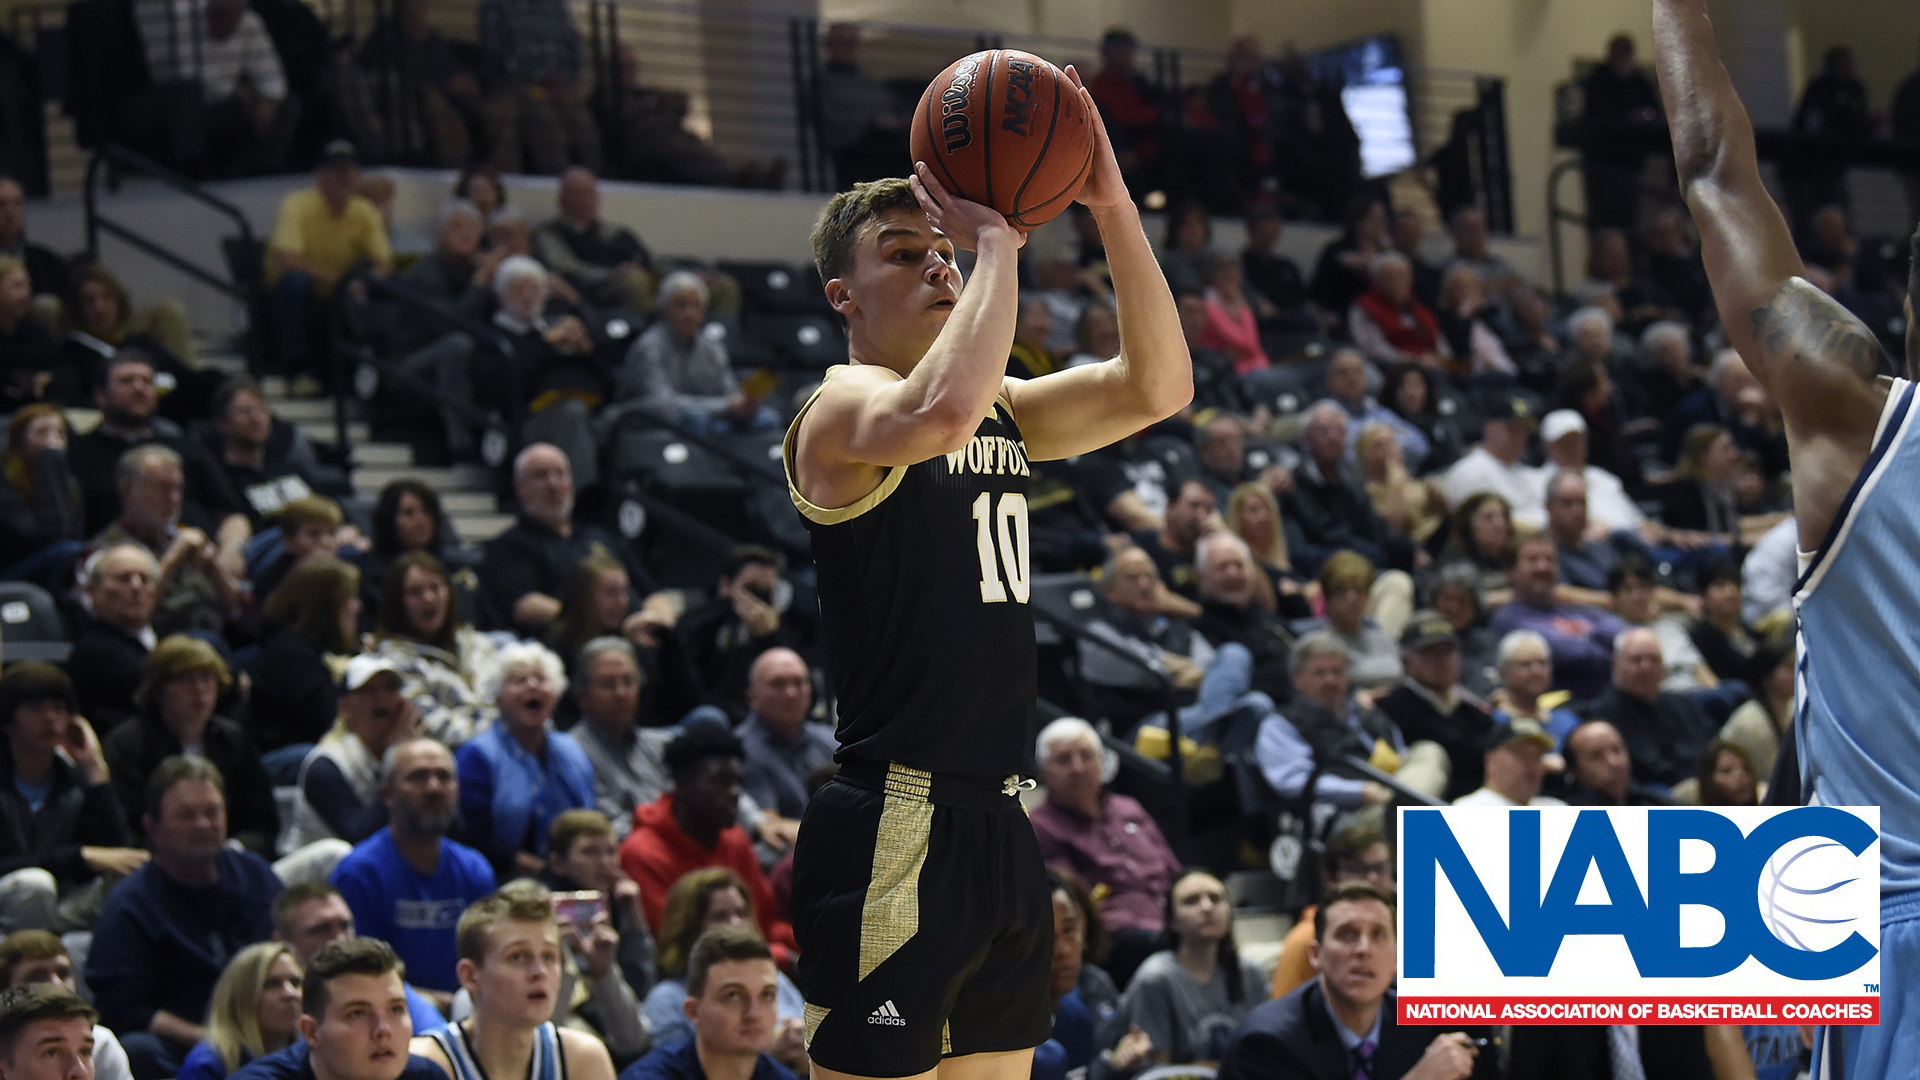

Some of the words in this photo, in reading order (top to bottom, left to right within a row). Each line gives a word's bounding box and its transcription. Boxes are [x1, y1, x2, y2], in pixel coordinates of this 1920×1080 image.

[1001, 59, 1035, 138] NCAA
[972, 491, 1031, 604] 10
[867, 1015, 906, 1027] adidas
